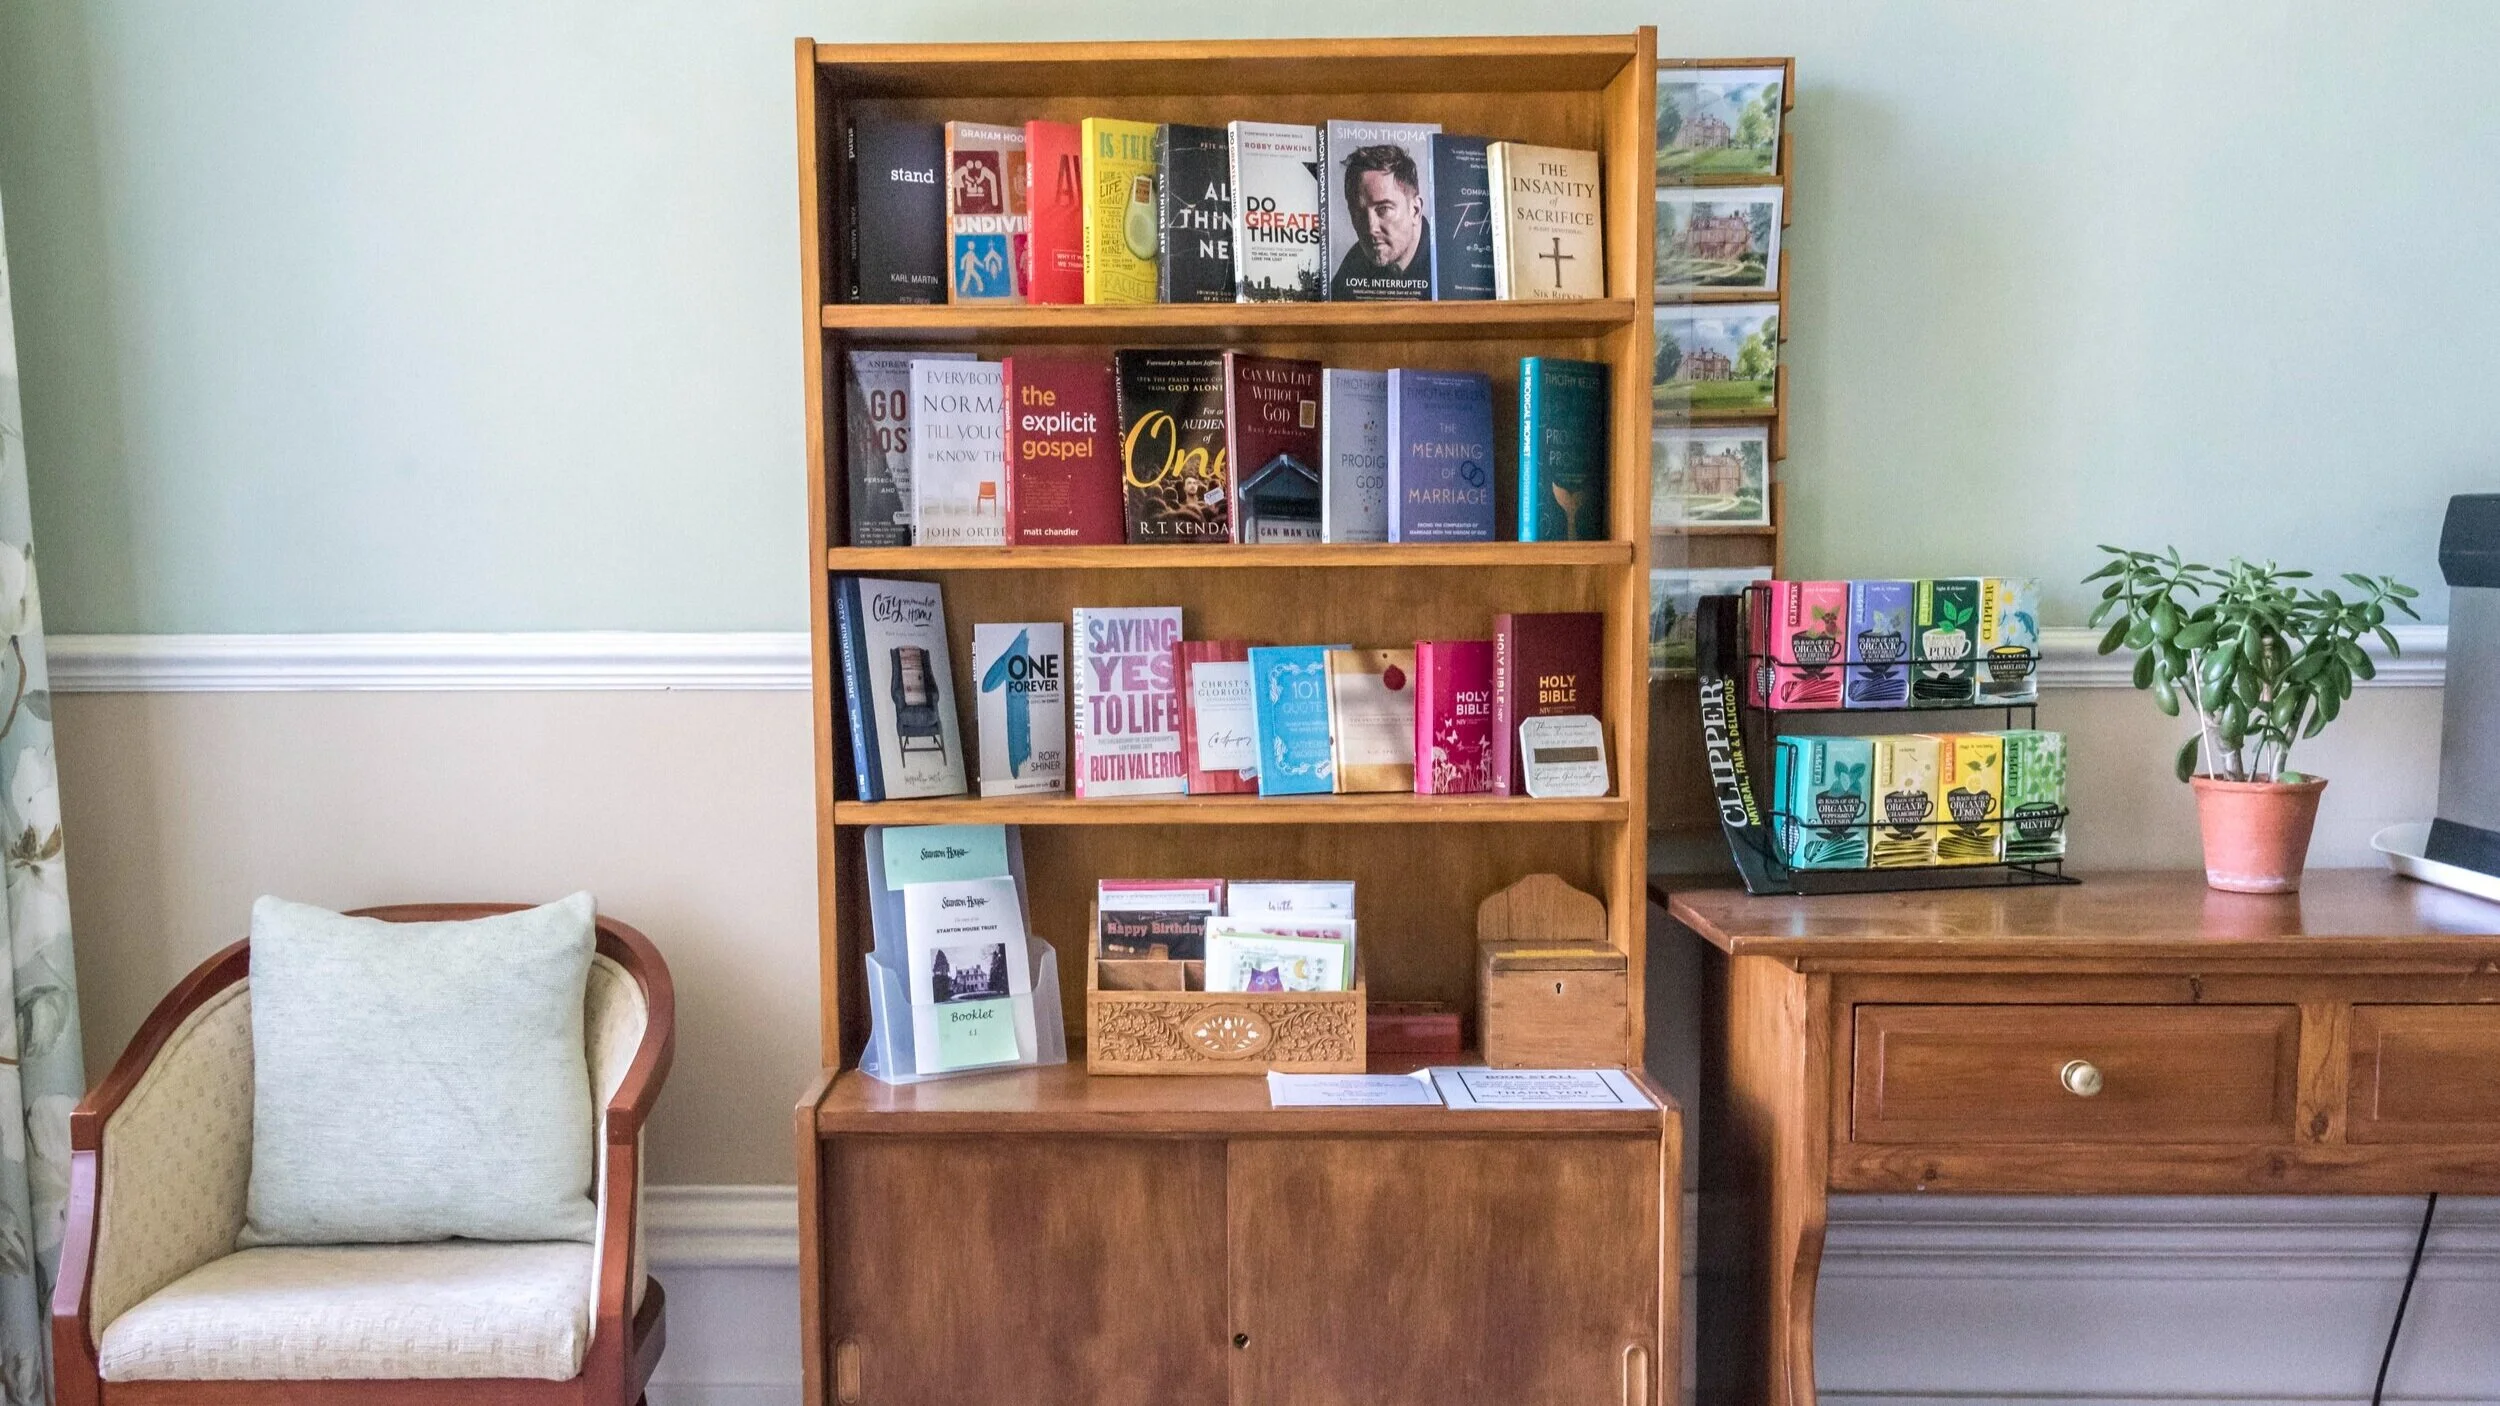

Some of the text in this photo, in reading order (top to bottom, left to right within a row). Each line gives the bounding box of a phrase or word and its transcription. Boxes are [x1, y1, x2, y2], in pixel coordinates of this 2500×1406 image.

[961, 128, 1025, 144] GRAHAM HOO
[1230, 132, 1236, 145] DO
[1337, 127, 1433, 141] SIMON THOMA
[1100, 132, 1114, 158] IS
[1244, 142, 1312, 152] ROBBY DAWKINS
[890, 168, 935, 184] stand
[1538, 162, 1568, 177] THE
[1100, 179, 1121, 197] LIFE
[1204, 182, 1231, 202] AL
[1461, 188, 1489, 196] COMPA
[1512, 177, 1595, 198] INSANITY
[1247, 196, 1276, 213] DO
[1549, 197, 1558, 207] of
[1180, 208, 1234, 231] THIN
[1245, 211, 1319, 230] GREATE
[1517, 207, 1594, 226] SACRIFICE
[1247, 226, 1320, 244] THINGS
[1199, 240, 1229, 259] NE
[1321, 236, 1329, 296] INTERRUPTED
[890, 273, 938, 285] KARL MARTIN
[1346, 278, 1429, 289] LOVE, INTERRUPTED
[1266, 369, 1287, 383] MAN
[1021, 385, 1056, 406] the
[1252, 386, 1300, 402] WITHOUT
[870, 389, 906, 421] GO
[1203, 407, 1214, 415] For
[1022, 411, 1097, 435] explicit
[1523, 377, 1531, 457] PRODIGAL PROPHET
[926, 424, 991, 440] TILL YOU
[1181, 420, 1224, 430] AUDIEN
[1439, 423, 1457, 433] THE
[1203, 432, 1213, 444] of
[1023, 437, 1093, 460] gospel
[1412, 443, 1484, 460] MEANING
[935, 450, 978, 463] KNOW
[1341, 453, 1388, 469] PRODIG
[1441, 468, 1456, 479] OF
[1356, 475, 1384, 489] GOD
[1408, 488, 1487, 505] MARRIAGE
[926, 527, 961, 539] JOHN
[1023, 527, 1079, 536] matt chandler
[1140, 522, 1229, 535] R. T. KENDA
[1261, 528, 1320, 537] CAN MAN LIV
[1790, 584, 1798, 625] CLIPPER
[1983, 585, 1994, 640] CLIPPER
[1088, 618, 1178, 654] SAYING
[837, 598, 855, 699] COZY MINIMALIST HOME
[1794, 645, 1833, 653] ORGANIC
[1860, 642, 1898, 650] ORGANIC
[1925, 647, 1957, 657] PURE
[1008, 654, 1058, 680] ONE
[1088, 654, 1175, 692] YES
[1008, 680, 1058, 693] FOREVER
[1201, 680, 1249, 689] CHRIST'S
[1539, 675, 1576, 688] HOLY
[1291, 681, 1320, 699] 101
[1456, 691, 1489, 703] HOLY
[1539, 690, 1576, 703] BIBLE
[1088, 694, 1123, 735] TO
[1127, 692, 1180, 734] LIFE
[1283, 701, 1328, 714] QUOTE
[1456, 704, 1490, 715] BIBLE
[1724, 678, 1738, 737] DELICIOUS
[1733, 739, 1741, 748] &
[1038, 752, 1060, 762] RORY
[1700, 678, 1748, 828] CLIPPER
[1031, 761, 1061, 772] SHINER
[1090, 753, 1127, 782] RUTH
[1734, 750, 1745, 774] FAIR
[1815, 745, 1823, 784] CLIPPER
[2009, 743, 2018, 797] CLIPPER
[1819, 804, 1858, 812] ORGANIC
[1886, 803, 1925, 811] ORGANIC
[1950, 801, 1987, 809] ORGANIC
[1953, 808, 1984, 817] LEMON
[920, 846, 971, 860] Stanton House
[941, 896, 991, 909] Stanton House
[936, 926, 961, 934] STANTON
[1107, 921, 1206, 937] Happy Birthday
[951, 1009, 994, 1022] Booklet
